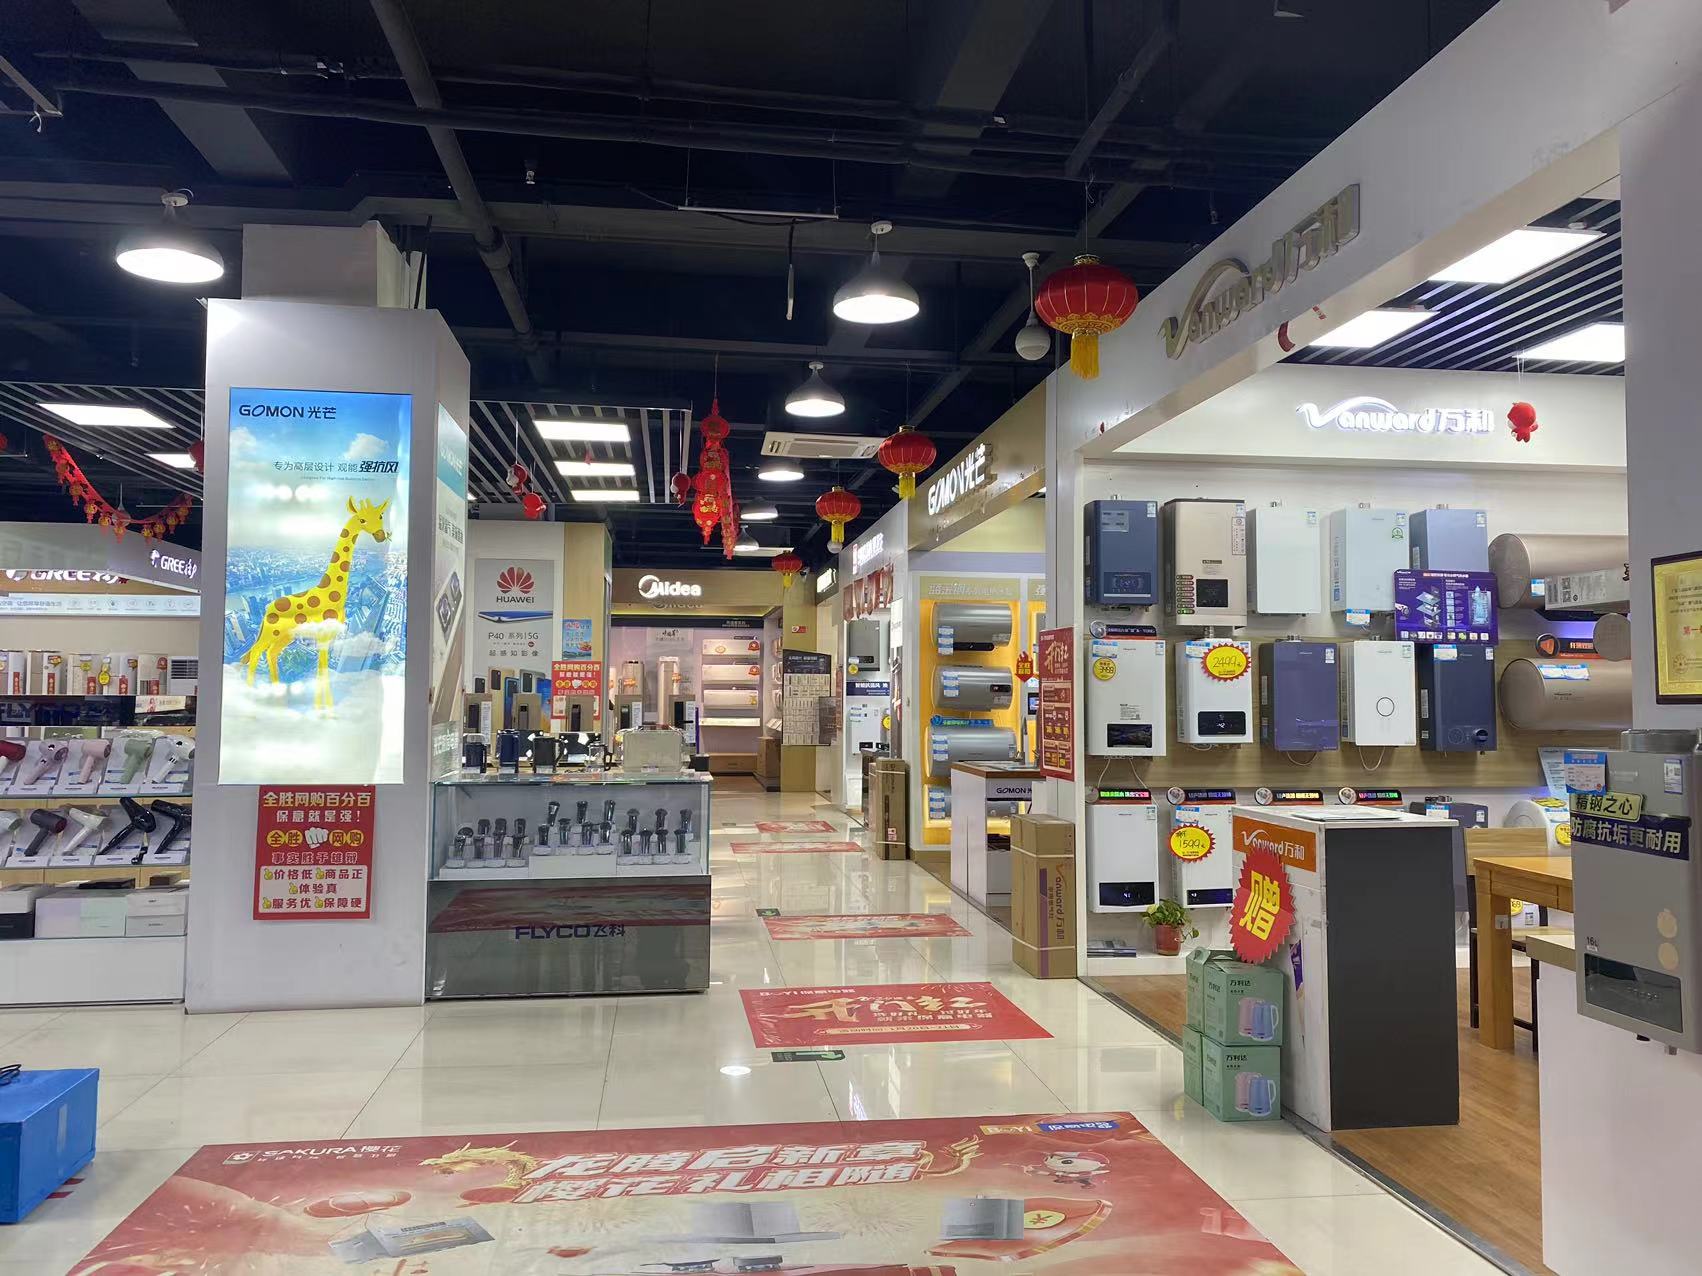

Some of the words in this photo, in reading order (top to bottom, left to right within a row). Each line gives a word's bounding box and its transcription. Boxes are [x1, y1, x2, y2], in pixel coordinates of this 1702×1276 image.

[239, 404, 304, 418] GOMON
[307, 405, 337, 420] 光芒
[274, 461, 335, 473] 专为高层设计
[643, 576, 702, 598] Midea
[496, 596, 535, 604] HUAWEI
[488, 632, 505, 640] P40
[263, 792, 371, 807] 全胜网购百分百
[270, 831, 301, 845] 全胜
[333, 831, 362, 845] 网购
[1571, 817, 1681, 854] 防腐抗垢更耐用
[274, 868, 313, 880] 价格低
[325, 868, 363, 880] 商品正
[299, 883, 337, 894] 体验真
[272, 898, 311, 909] 服务优
[324, 898, 362, 909] 保障硬
[1239, 870, 1281, 941] 赠
[261, 1145, 356, 1157] SAKURA
[520, 1141, 922, 1178] 龙腾启新章
[514, 1163, 919, 1202] 樱花礼相随
